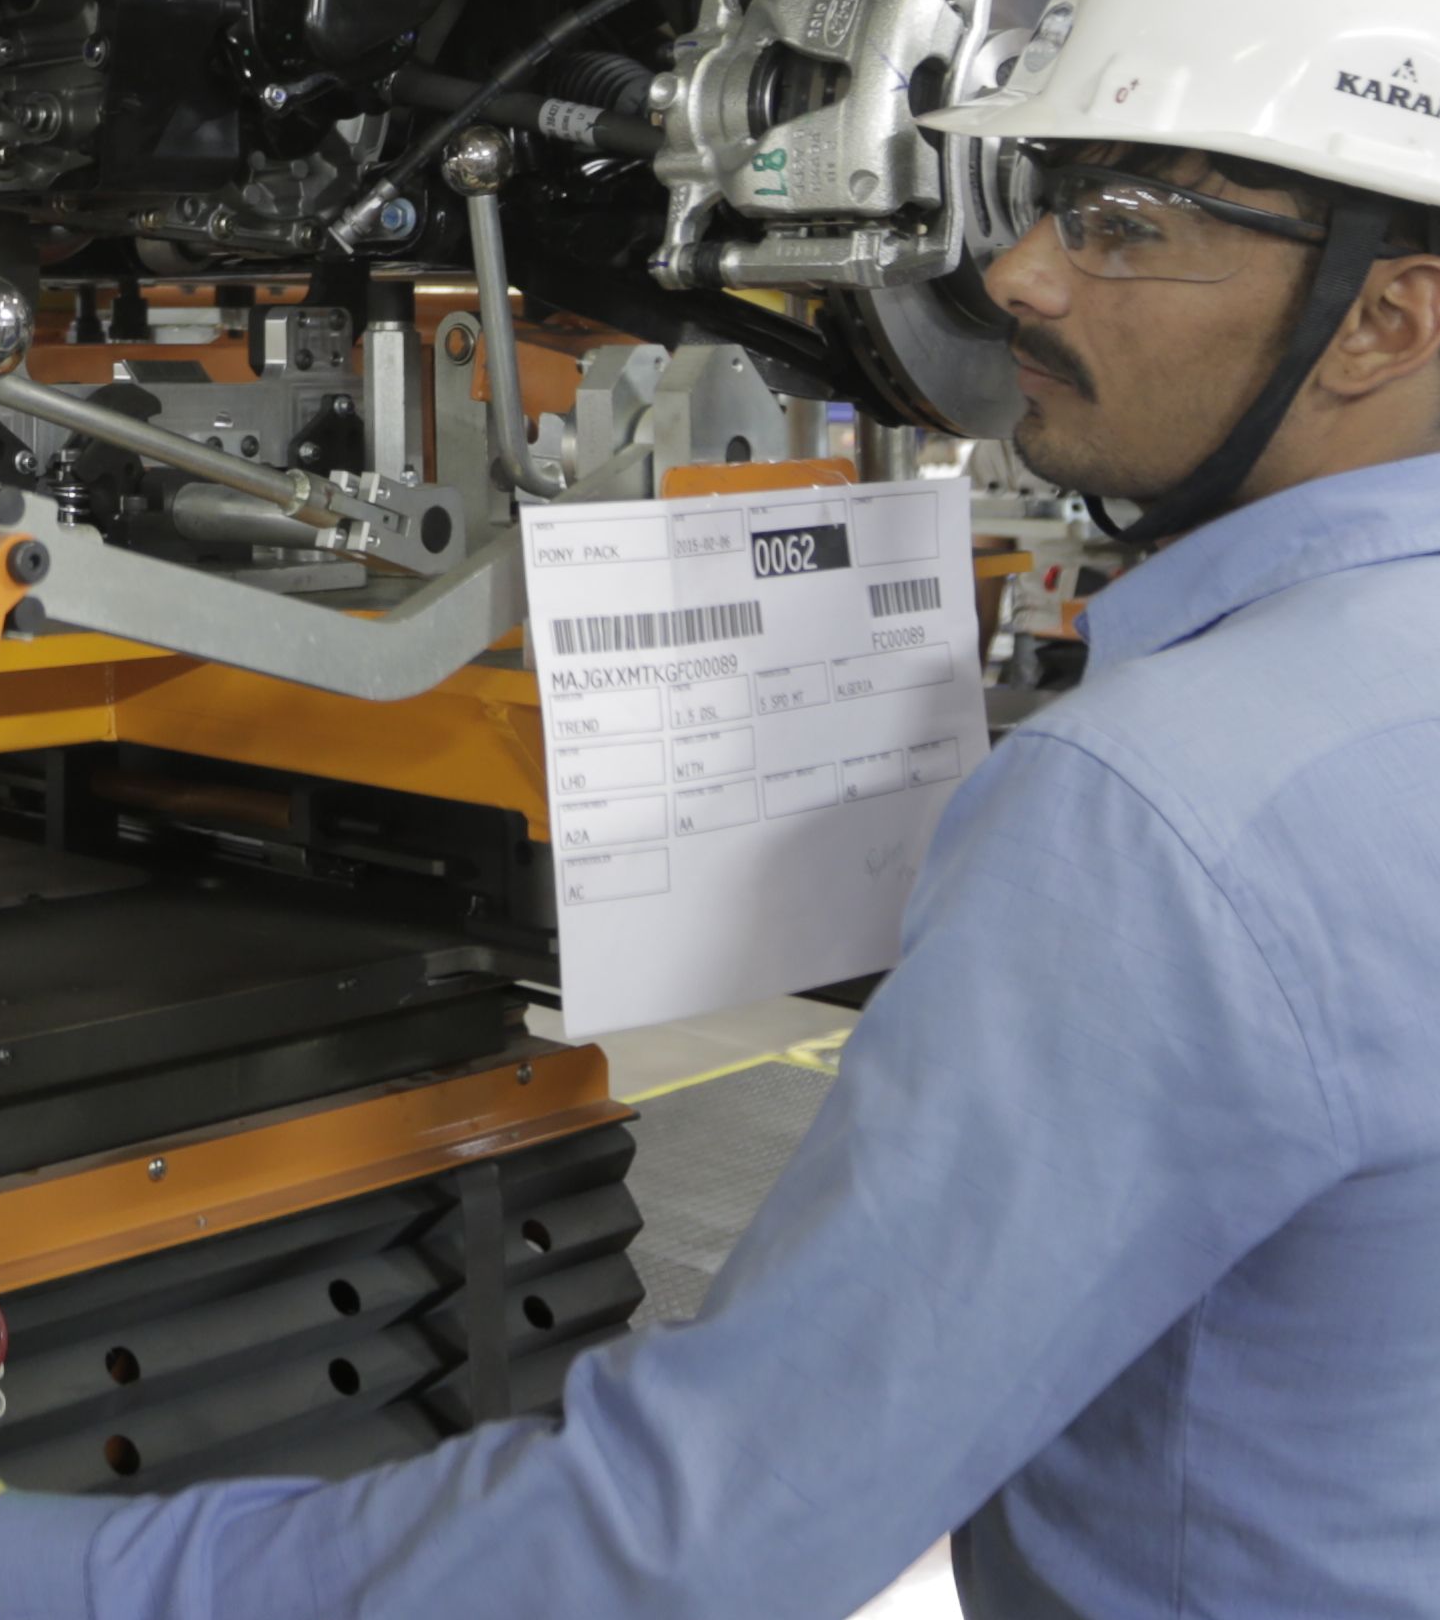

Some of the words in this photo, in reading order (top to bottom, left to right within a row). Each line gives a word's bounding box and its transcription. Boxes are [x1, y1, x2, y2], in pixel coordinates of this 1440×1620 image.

[538, 547, 573, 564] PONY
[583, 545, 620, 560] PACK
[754, 534, 818, 576] 0062
[871, 626, 926, 650] FC00089
[557, 719, 600, 736] TREND
